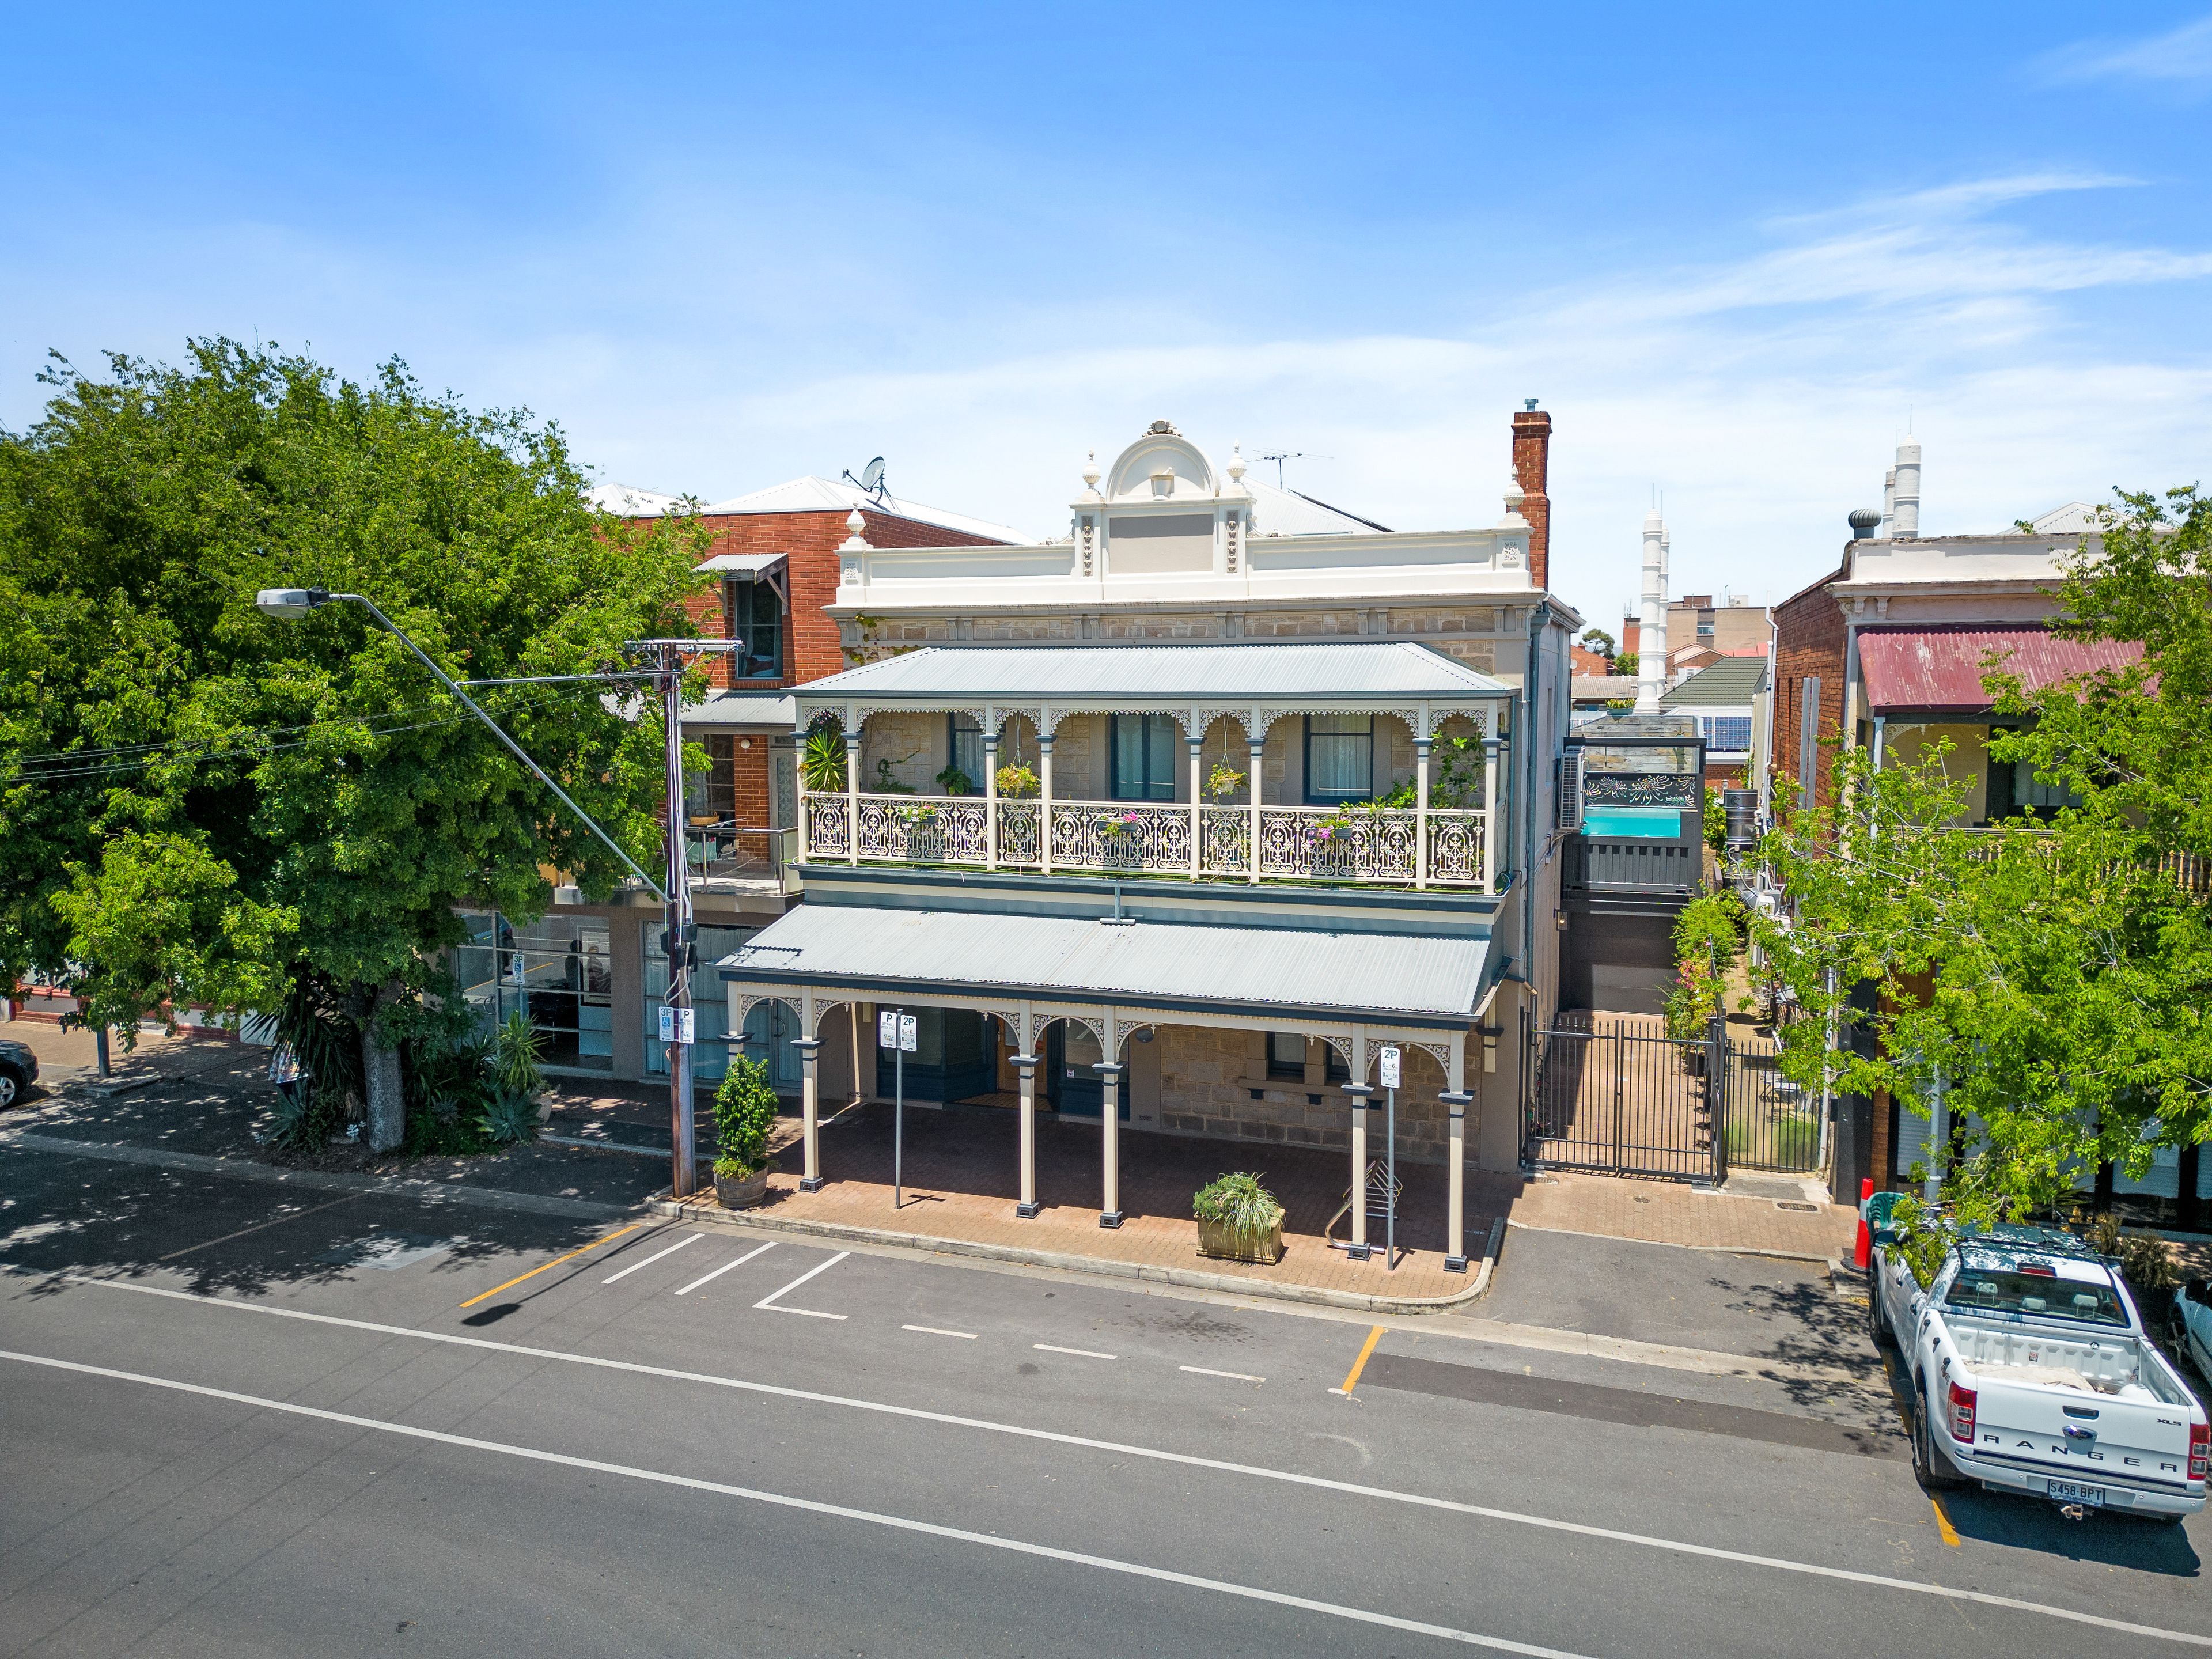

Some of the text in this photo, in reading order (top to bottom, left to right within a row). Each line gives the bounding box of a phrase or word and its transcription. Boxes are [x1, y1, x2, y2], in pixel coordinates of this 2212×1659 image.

[661, 1008, 672, 1016] 3P
[684, 1010, 690, 1018] P
[887, 1014, 893, 1022] P
[903, 1017, 914, 1026] 2P
[1384, 1050, 1397, 1059] 2P
[2156, 1418, 2182, 1426] XLS
[1983, 1434, 2177, 1472] RANGER
